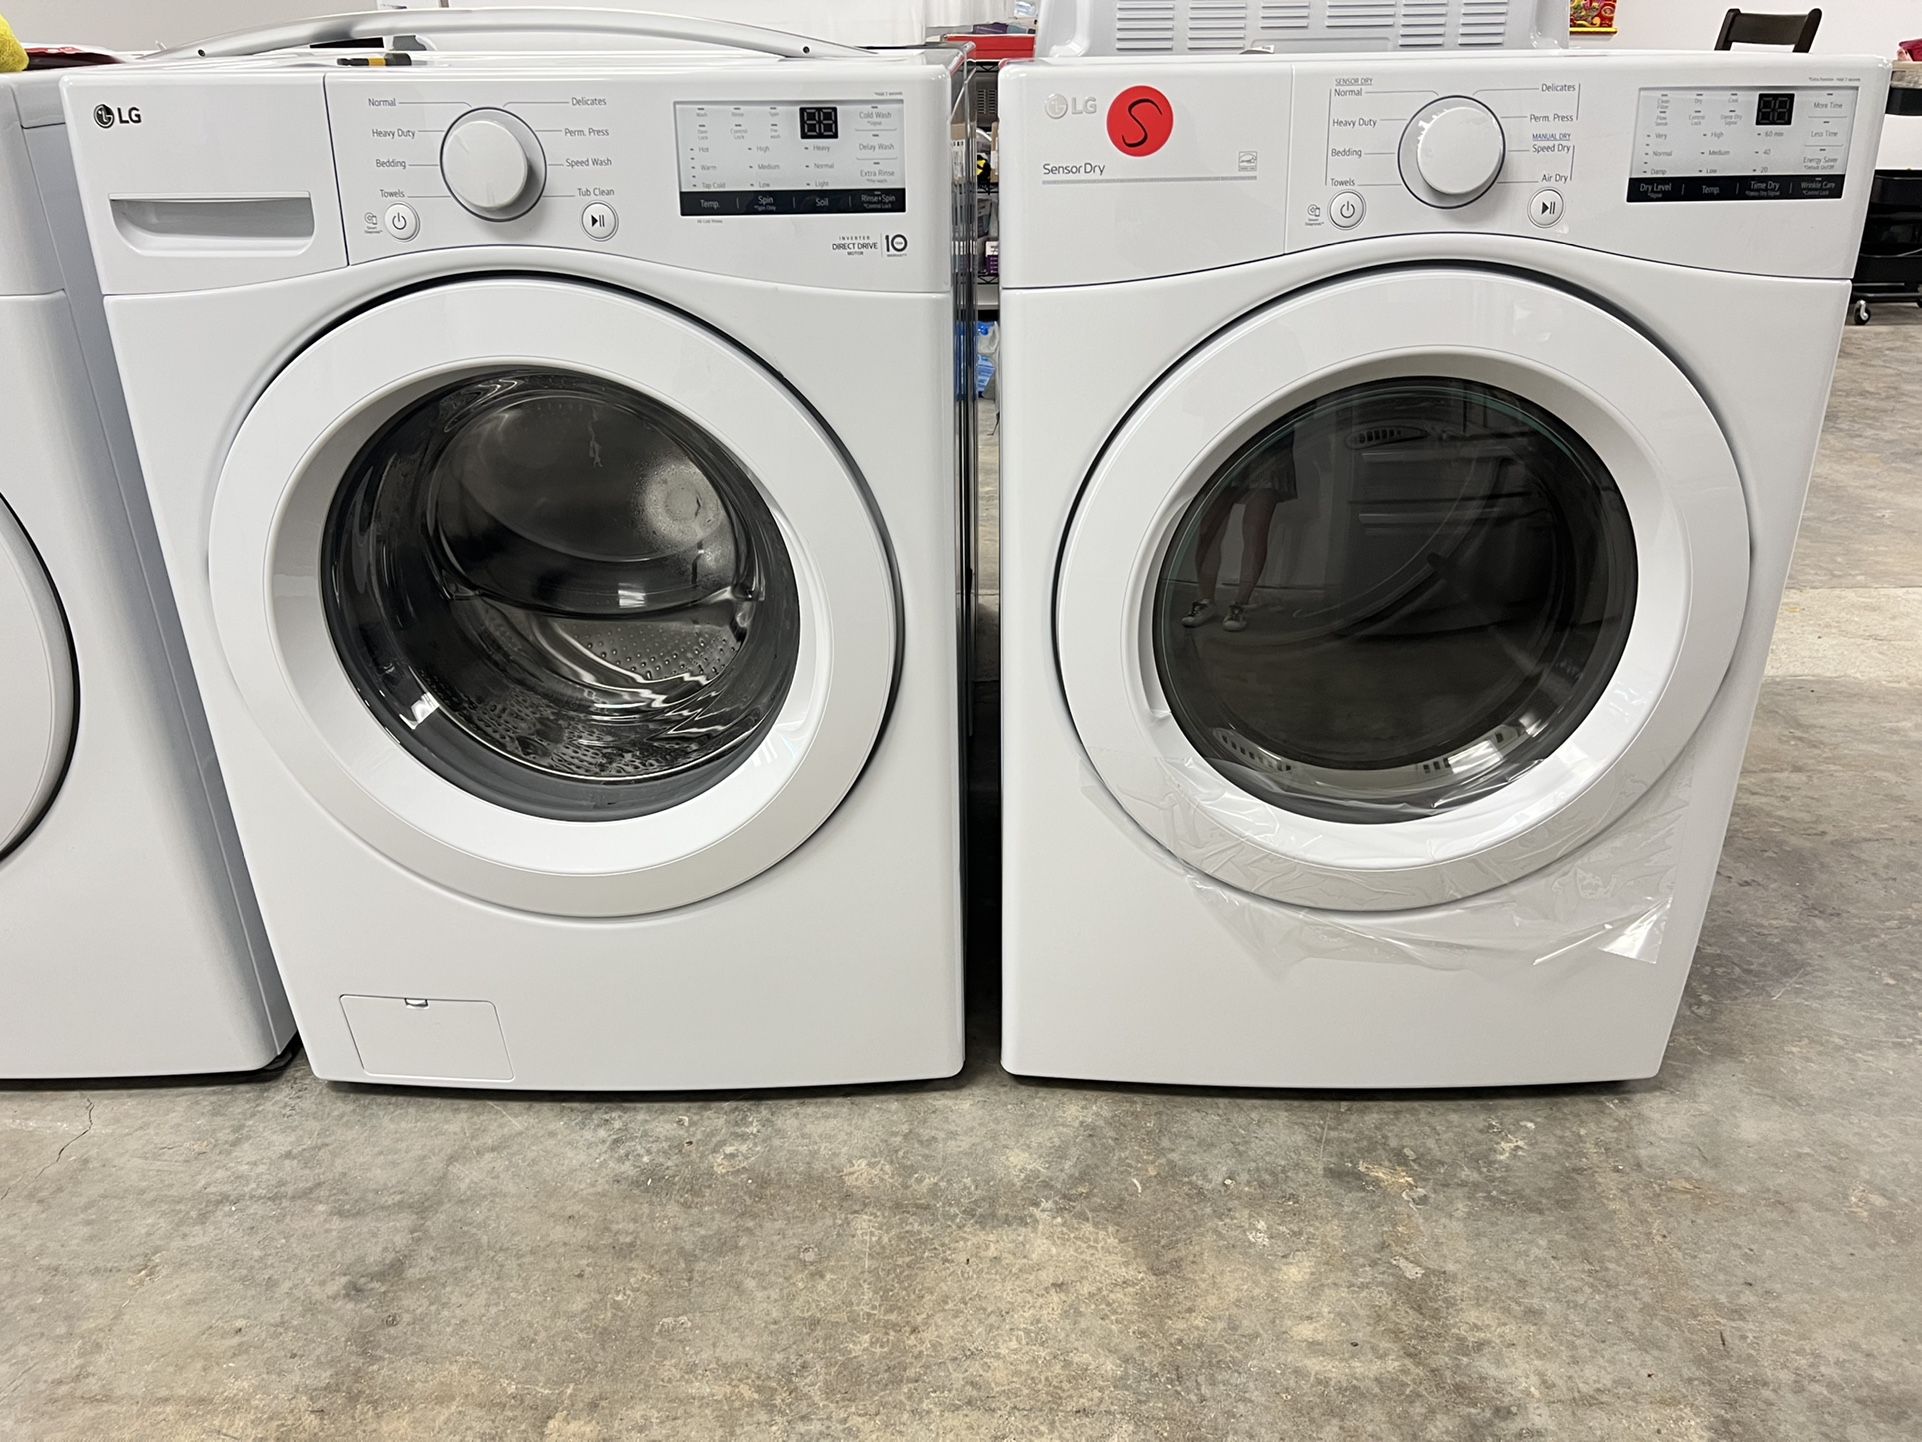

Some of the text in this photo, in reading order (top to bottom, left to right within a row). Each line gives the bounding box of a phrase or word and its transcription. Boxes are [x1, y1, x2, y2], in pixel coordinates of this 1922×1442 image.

[1335, 77, 1373, 85] SENSOR DRY
[1334, 87, 1363, 96] Normal
[1541, 83, 1576, 92] Delicates
[368, 98, 396, 107] Normal
[572, 97, 607, 106] Delicates
[1071, 96, 1097, 115] LG
[117, 107, 142, 124] LG
[859, 111, 892, 119] Cold Wash
[1553, 113, 1574, 121] Press
[1121, 98, 1162, 148] S
[1332, 118, 1377, 128] Heavy Duty
[372, 128, 416, 139] Heavy Duty
[564, 128, 609, 137] Perm. Press
[1532, 132, 1557, 140] MANUAL
[1710, 131, 1724, 139] High
[756, 145, 770, 153] High
[813, 144, 831, 152] Heavy
[859, 143, 876, 151] Delay
[1532, 143, 1571, 154] Speed Dry
[1331, 148, 1362, 158] Bedding
[376, 159, 406, 170] Bedding
[566, 158, 612, 168] Speed Wash
[860, 169, 895, 177] Extra Rinse
[1042, 162, 1106, 175] Sensor Dry
[1330, 178, 1355, 187] Towels
[1541, 173, 1568, 184] Air Dry
[815, 180, 829, 188] Light
[1639, 182, 1672, 192] Dry Level
[1750, 181, 1780, 191] Time Dry
[380, 189, 405, 198] Towels
[577, 187, 615, 197] Tub Clean
[758, 195, 774, 205] Spin
[815, 197, 829, 206] Soil
[832, 242, 878, 250] DIRECT DRIVE
[885, 234, 908, 252] 10
